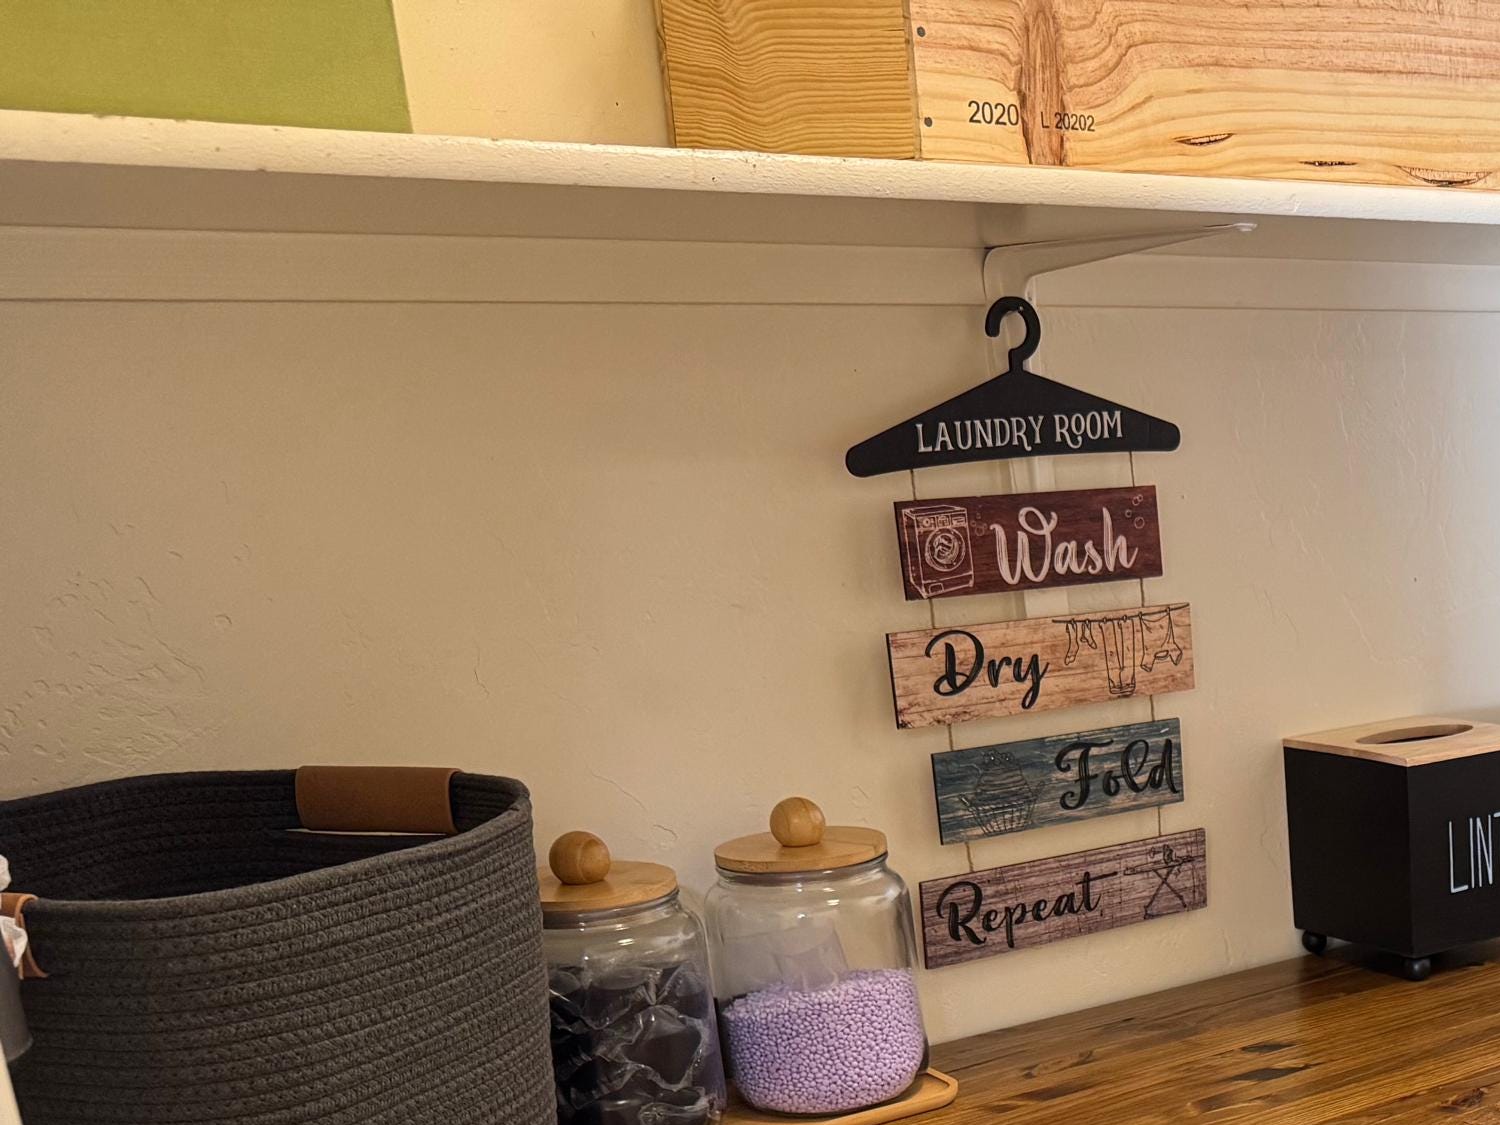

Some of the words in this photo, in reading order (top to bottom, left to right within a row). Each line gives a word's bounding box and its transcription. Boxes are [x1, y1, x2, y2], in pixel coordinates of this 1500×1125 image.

[968, 99, 1020, 126] 2020
[1041, 112, 1051, 129] L
[1054, 112, 1096, 132] 20202
[915, 414, 1045, 454] LAUNDRY
[1055, 411, 1124, 449] ROOM
[990, 506, 1138, 585] Wash
[925, 630, 1050, 709] Dry
[1056, 738, 1182, 811] Fold
[937, 870, 1118, 946] Repeat
